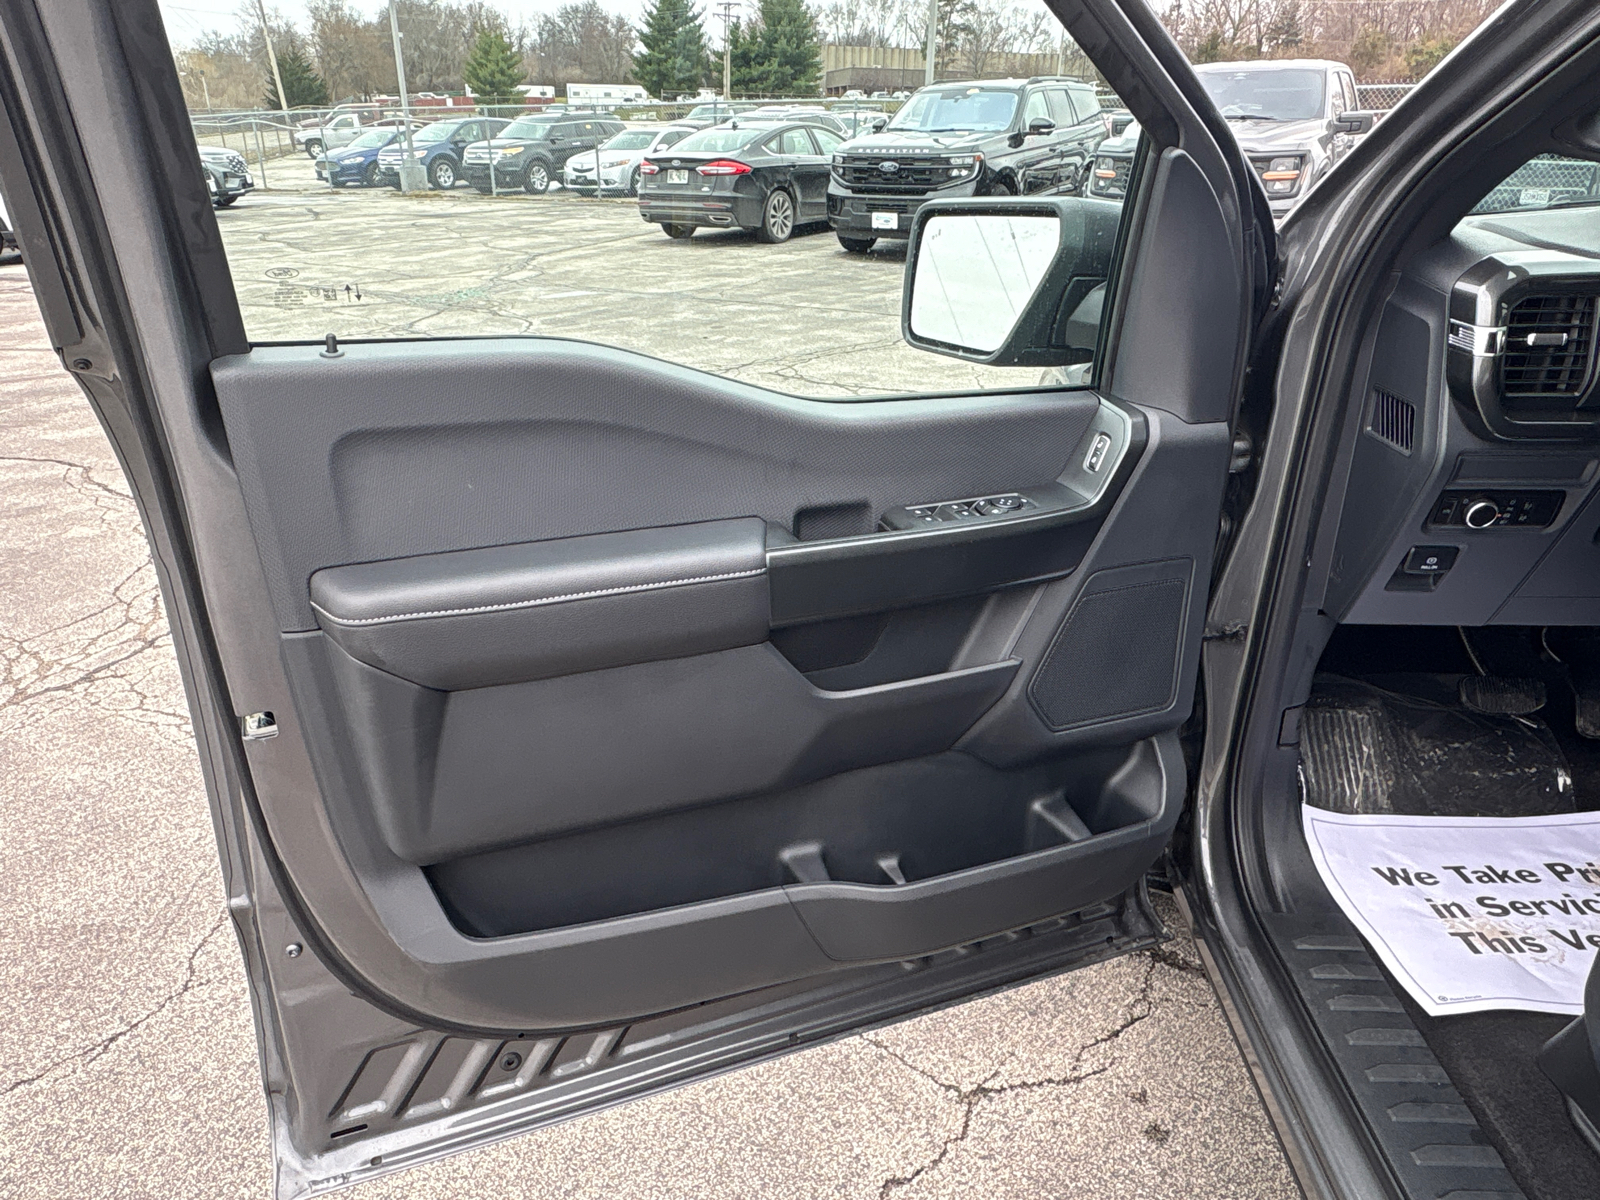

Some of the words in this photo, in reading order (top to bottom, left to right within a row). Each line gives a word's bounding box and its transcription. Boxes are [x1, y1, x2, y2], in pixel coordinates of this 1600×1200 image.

[1371, 867, 1440, 886] We
[1442, 865, 1542, 884] Take
[1424, 898, 1470, 919] in
[1475, 893, 1600, 917] Servic
[1448, 930, 1547, 955] This
